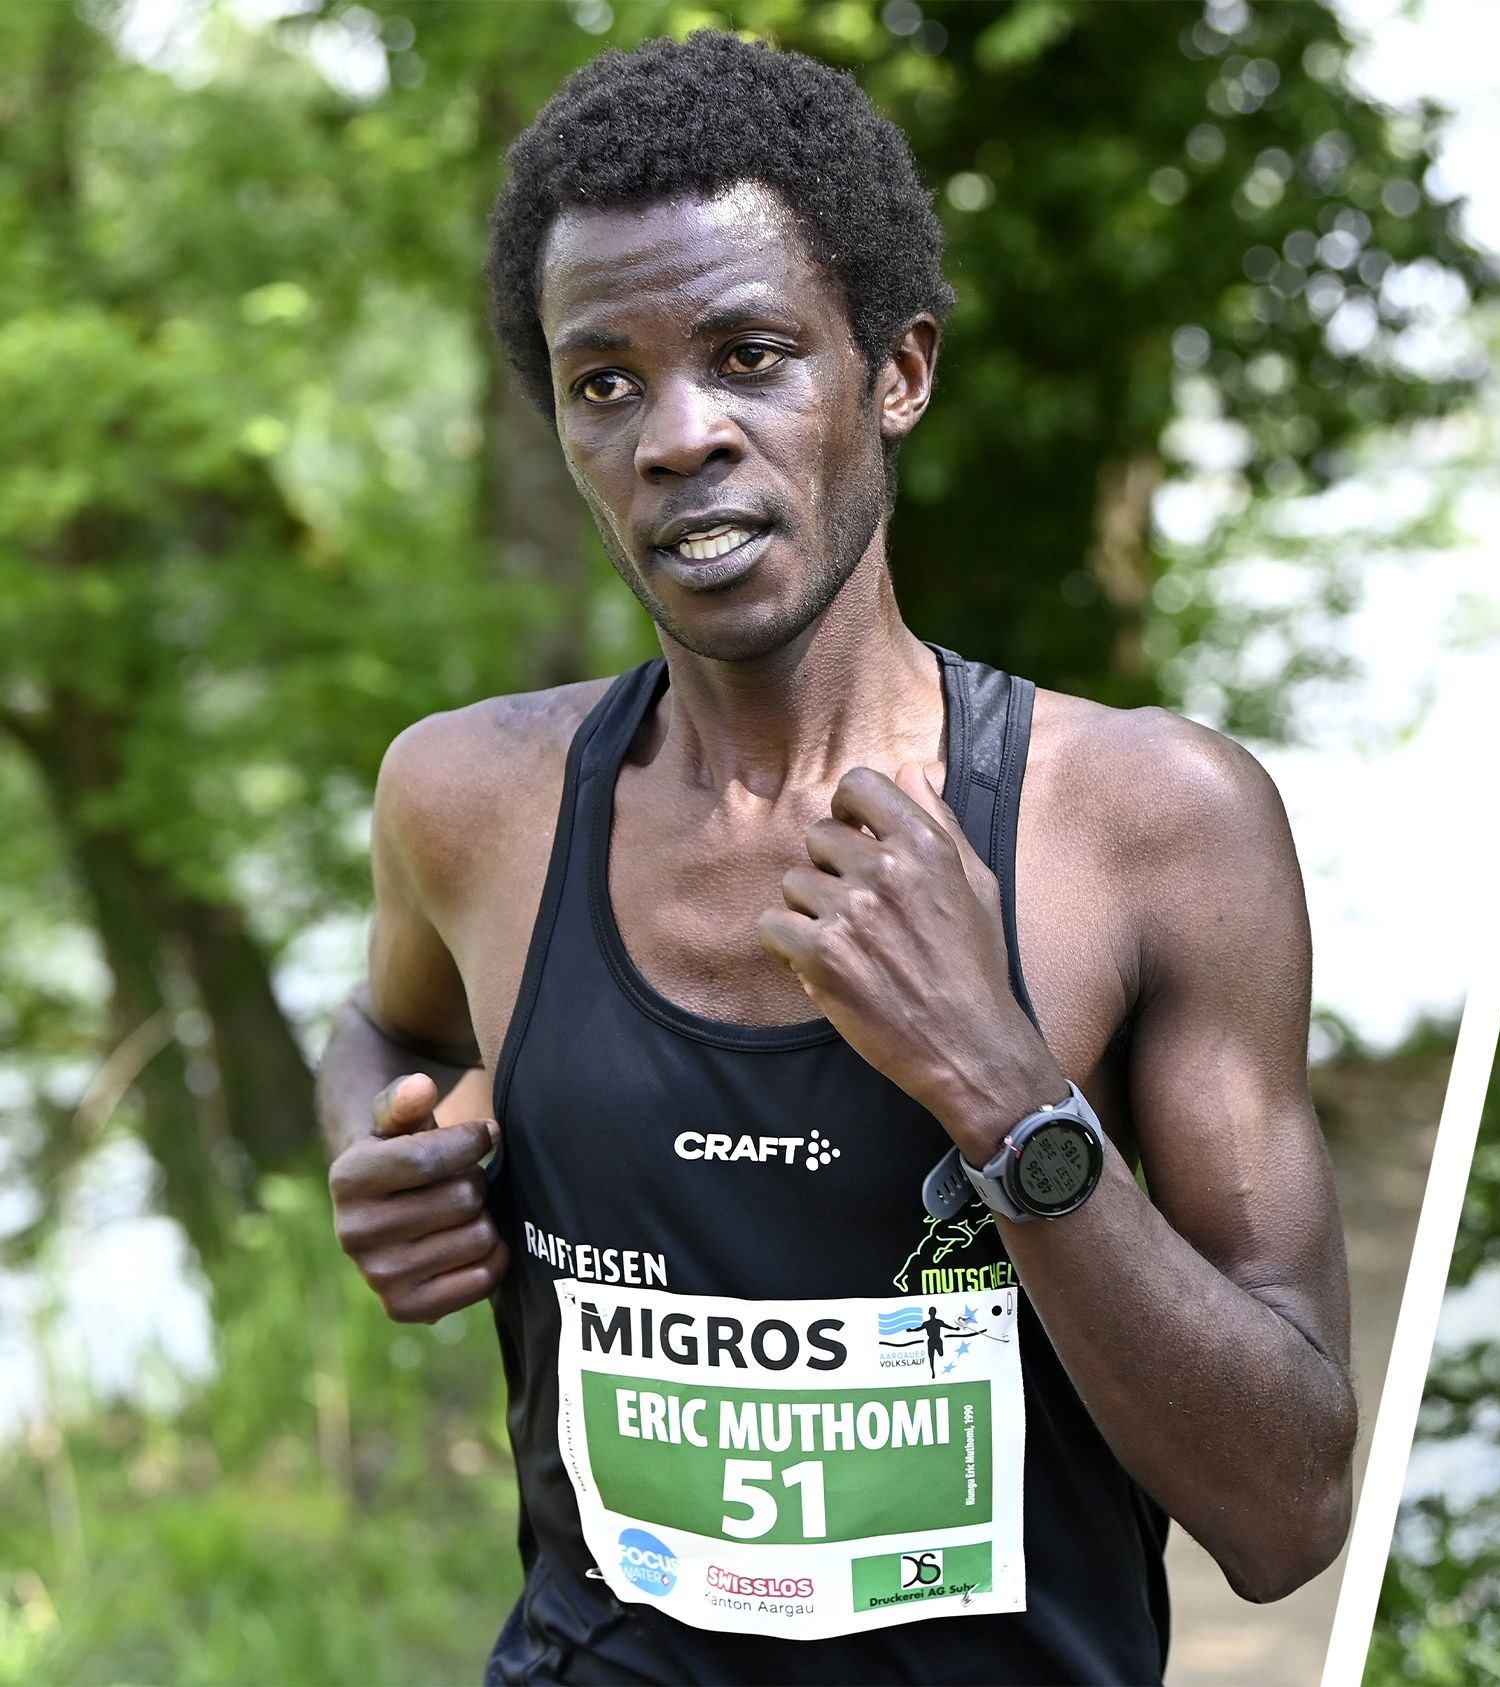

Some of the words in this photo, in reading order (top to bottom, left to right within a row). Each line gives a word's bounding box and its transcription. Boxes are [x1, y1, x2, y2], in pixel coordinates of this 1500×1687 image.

[674, 1131, 804, 1163] CRAFT
[581, 1302, 848, 1372] MIGROS
[879, 1358, 926, 1368] VOLKSLAUF
[880, 1351, 926, 1360] AARGAUER
[616, 1388, 709, 1450] ERIC
[718, 1396, 951, 1453] MUTHOMI
[963, 1405, 974, 1424] 1990
[963, 1425, 976, 1463] Muthomi,
[965, 1464, 975, 1478] Eric
[720, 1459, 829, 1539] 51
[618, 1544, 680, 1576] FOCUS
[706, 1565, 814, 1598] SWISSLOS
[869, 1590, 925, 1607] Druckerei
[927, 1585, 946, 1597] AG
[757, 1601, 815, 1617] Aargau
